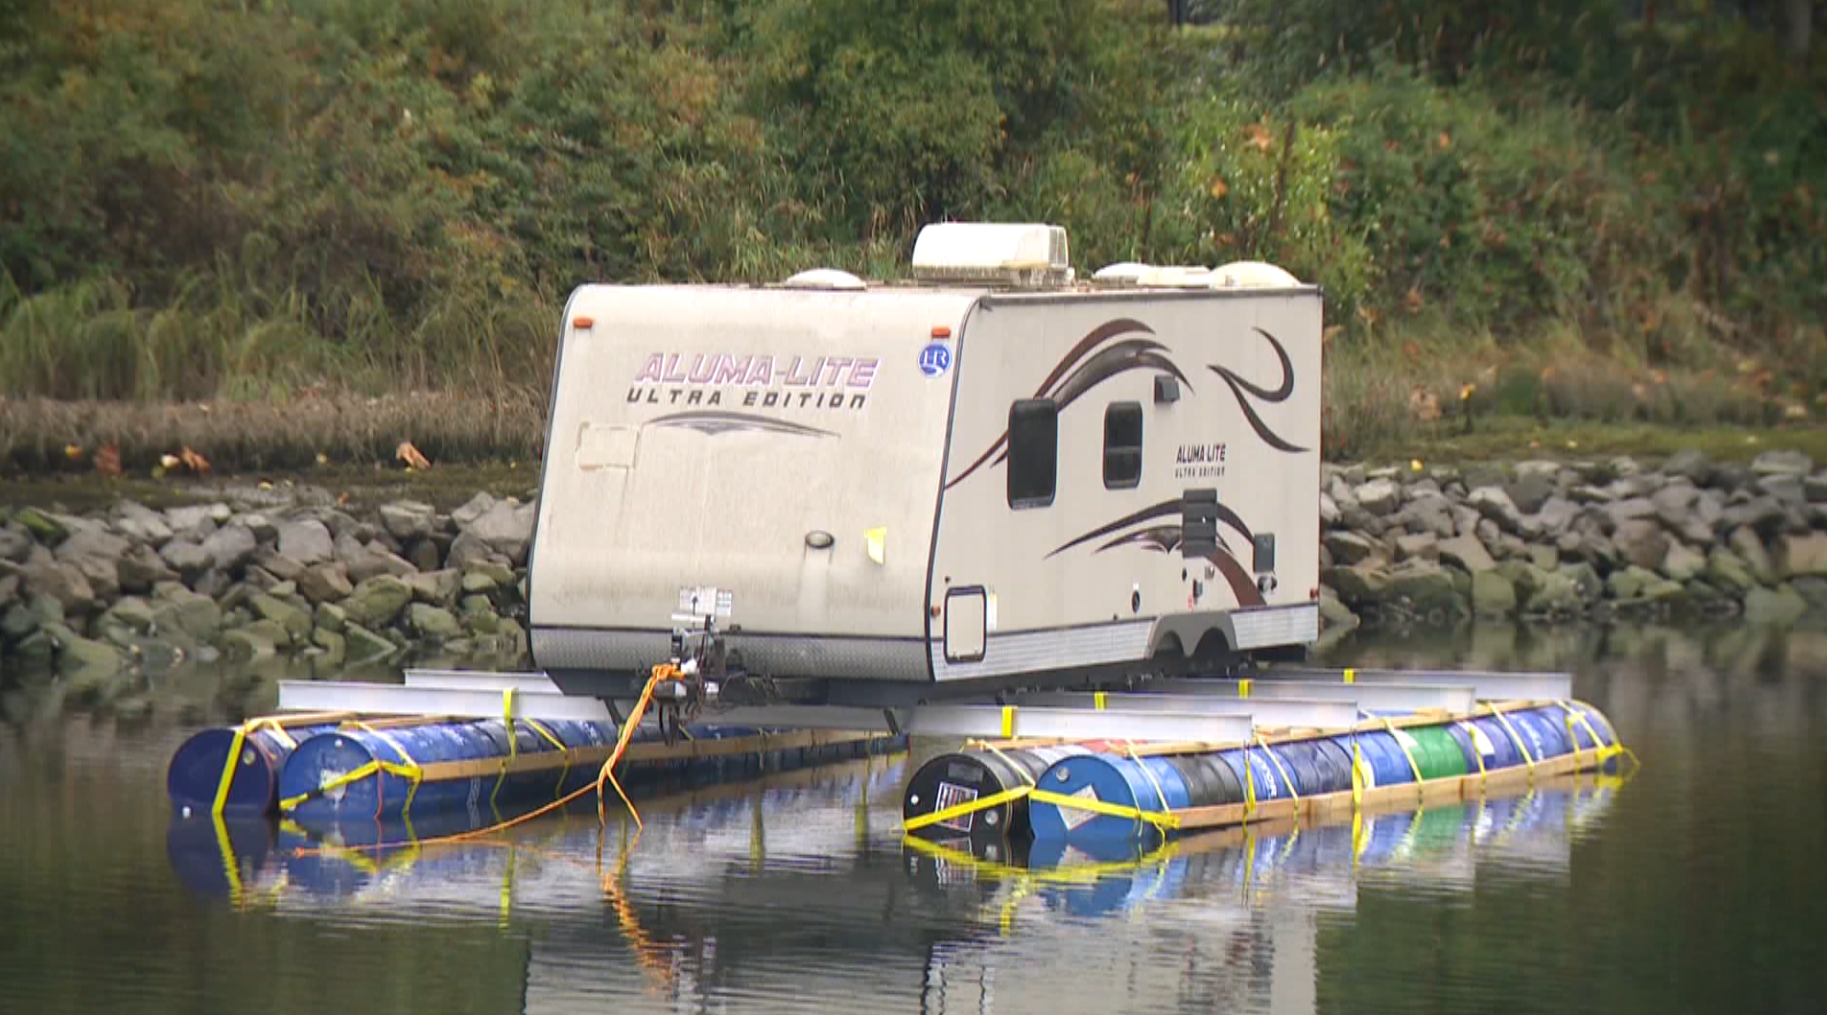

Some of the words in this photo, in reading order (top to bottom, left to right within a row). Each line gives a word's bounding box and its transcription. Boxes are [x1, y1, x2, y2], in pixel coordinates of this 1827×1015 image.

[634, 352, 880, 389] ALUMA-LITE
[626, 387, 722, 404] ULTRA
[742, 391, 867, 409] EDITION
